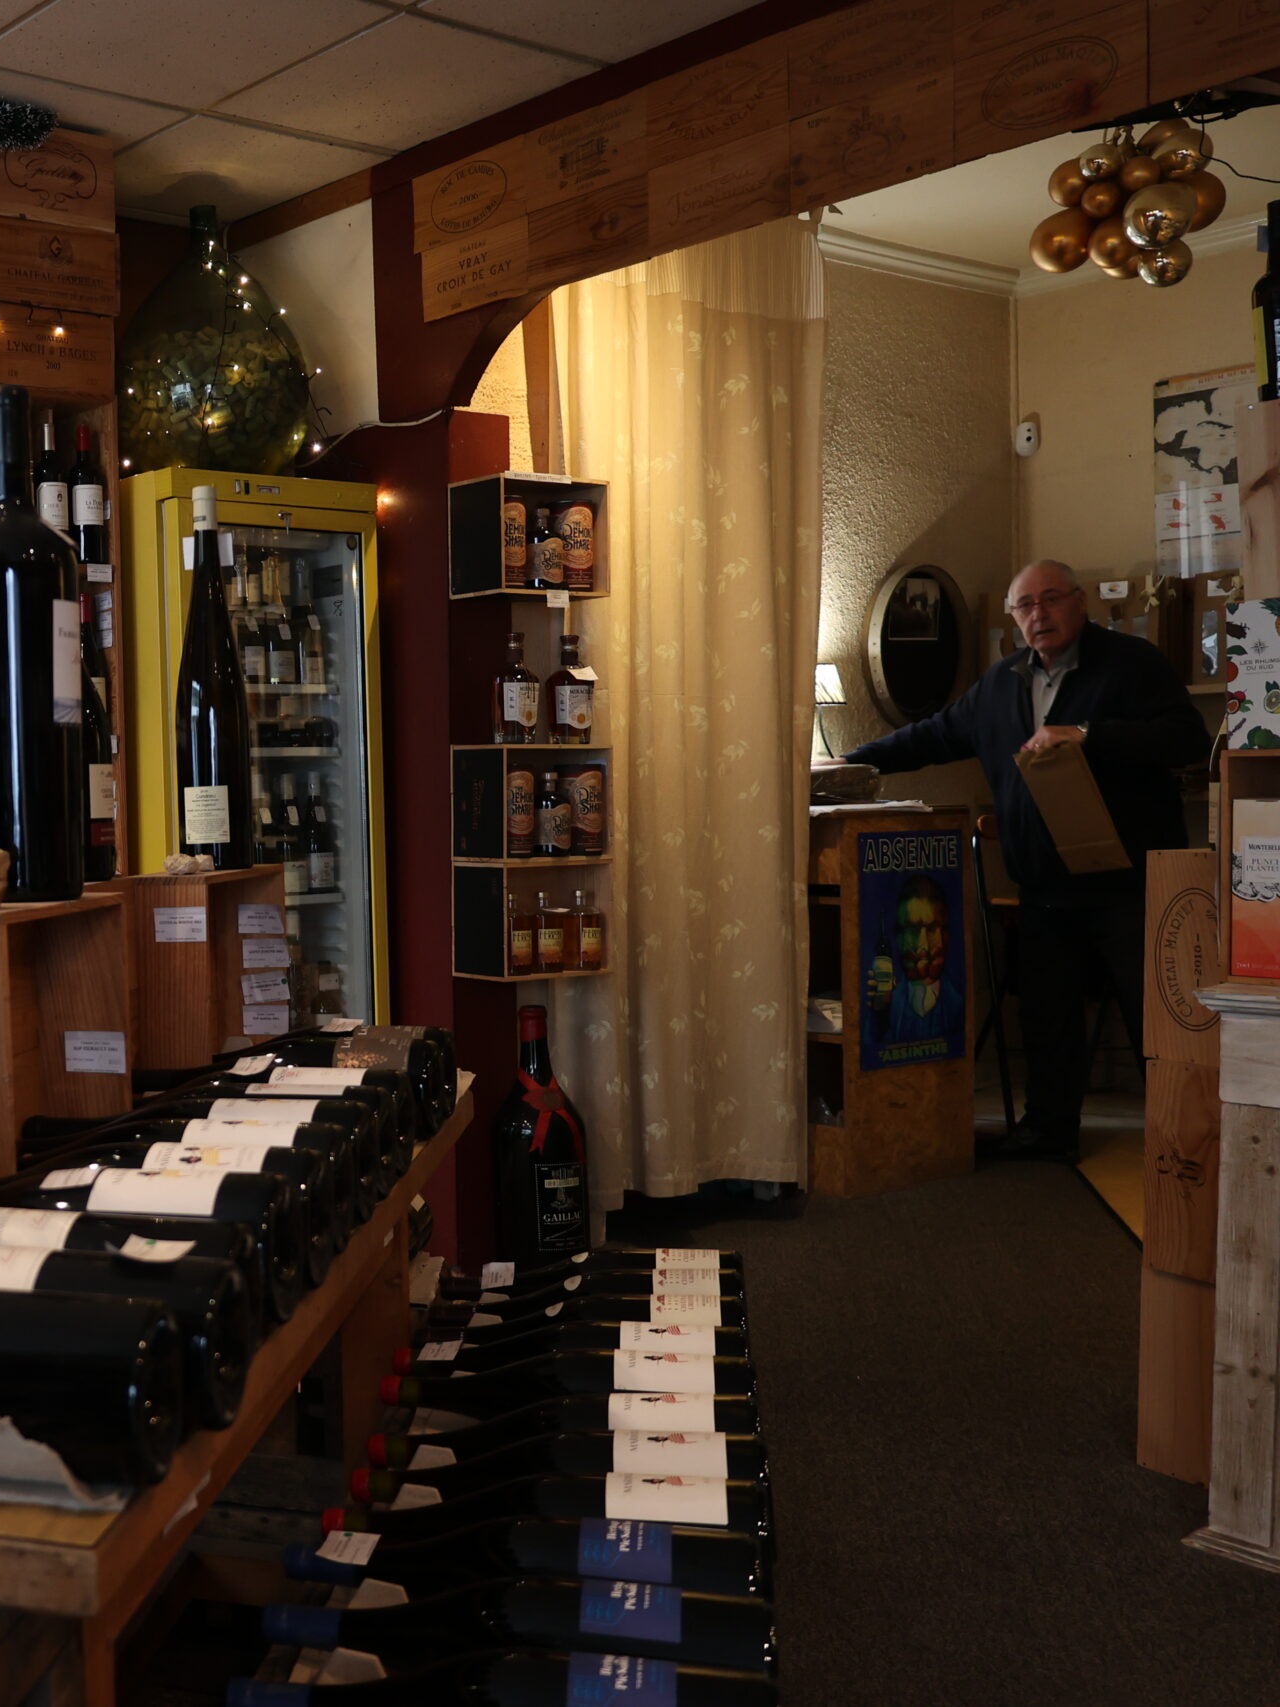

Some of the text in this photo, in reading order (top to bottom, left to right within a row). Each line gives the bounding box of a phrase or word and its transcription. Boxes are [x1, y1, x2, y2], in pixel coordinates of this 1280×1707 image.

[436, 259, 513, 294] CROIX DE GAY
[458, 251, 488, 271] VRAY
[862, 835, 959, 873] ABSENTE
[1193, 943, 1203, 978] 2010
